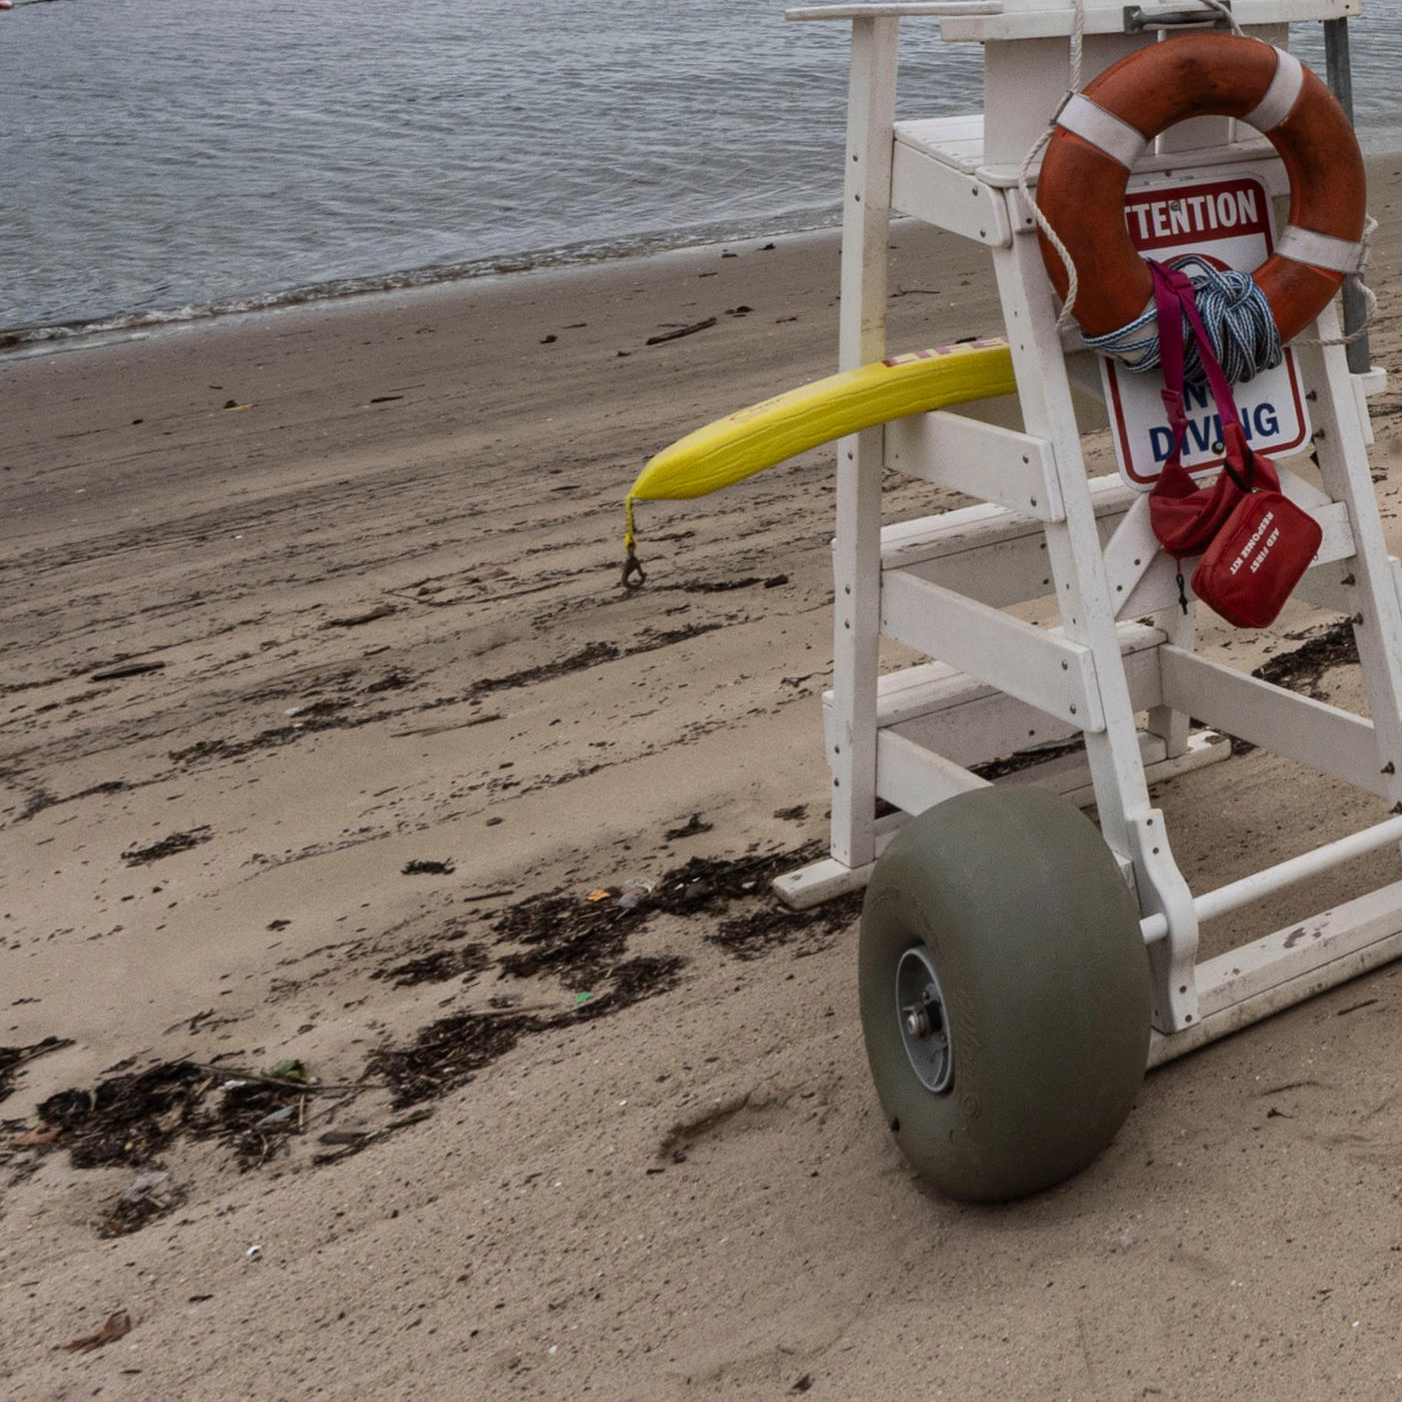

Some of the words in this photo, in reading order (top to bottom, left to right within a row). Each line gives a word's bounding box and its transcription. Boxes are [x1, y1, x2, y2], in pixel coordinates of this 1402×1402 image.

[881, 336, 1010, 368] LIFE
[1240, 511, 1274, 559] RESPONSE
[1266, 527, 1280, 547] AED
[1229, 557, 1244, 575] KIT
[1249, 546, 1269, 574] FIRST
